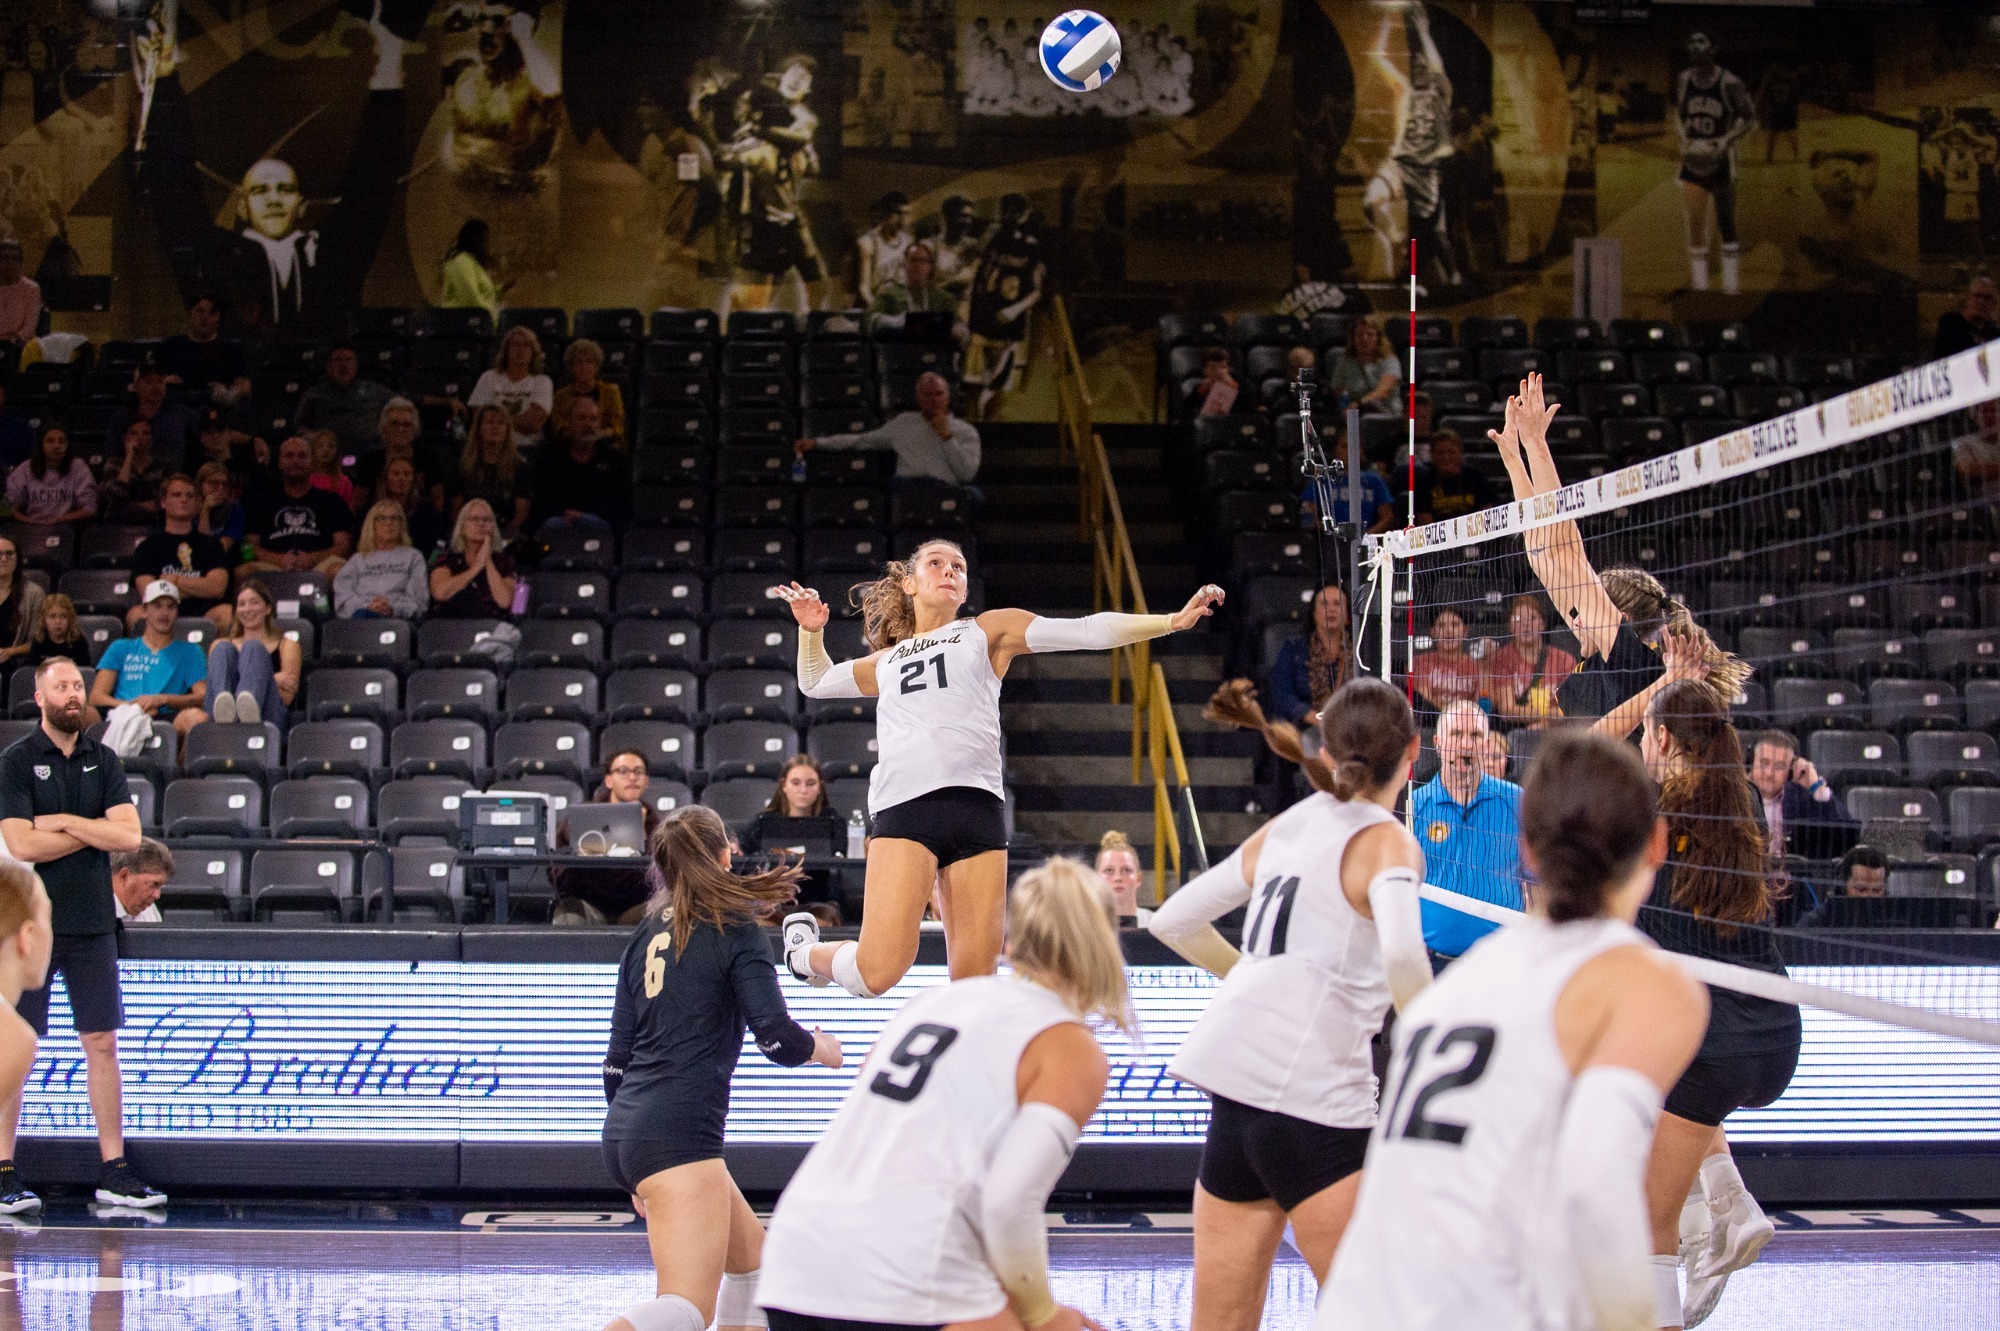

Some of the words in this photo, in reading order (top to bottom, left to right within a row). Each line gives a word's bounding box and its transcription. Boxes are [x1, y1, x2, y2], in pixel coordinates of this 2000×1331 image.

[1718, 430, 1753, 468] GOLDEN
[1752, 417, 1798, 458] GRIZZLIES
[1615, 474, 1643, 497] GOLDEN
[1642, 455, 1681, 489] GRIZZLIES
[1467, 514, 1484, 538] GOLDEN
[1483, 505, 1509, 534] GRIZZLIES
[1534, 499, 1556, 521] GOLDEN
[1555, 484, 1586, 514] GRIZZLIES
[126, 653, 160, 666] FAITH
[900, 652, 949, 696] 21
[1248, 875, 1302, 957] 11
[645, 931, 672, 999] 6
[870, 1023, 959, 1103] 9
[1384, 1025, 1497, 1146] 12
